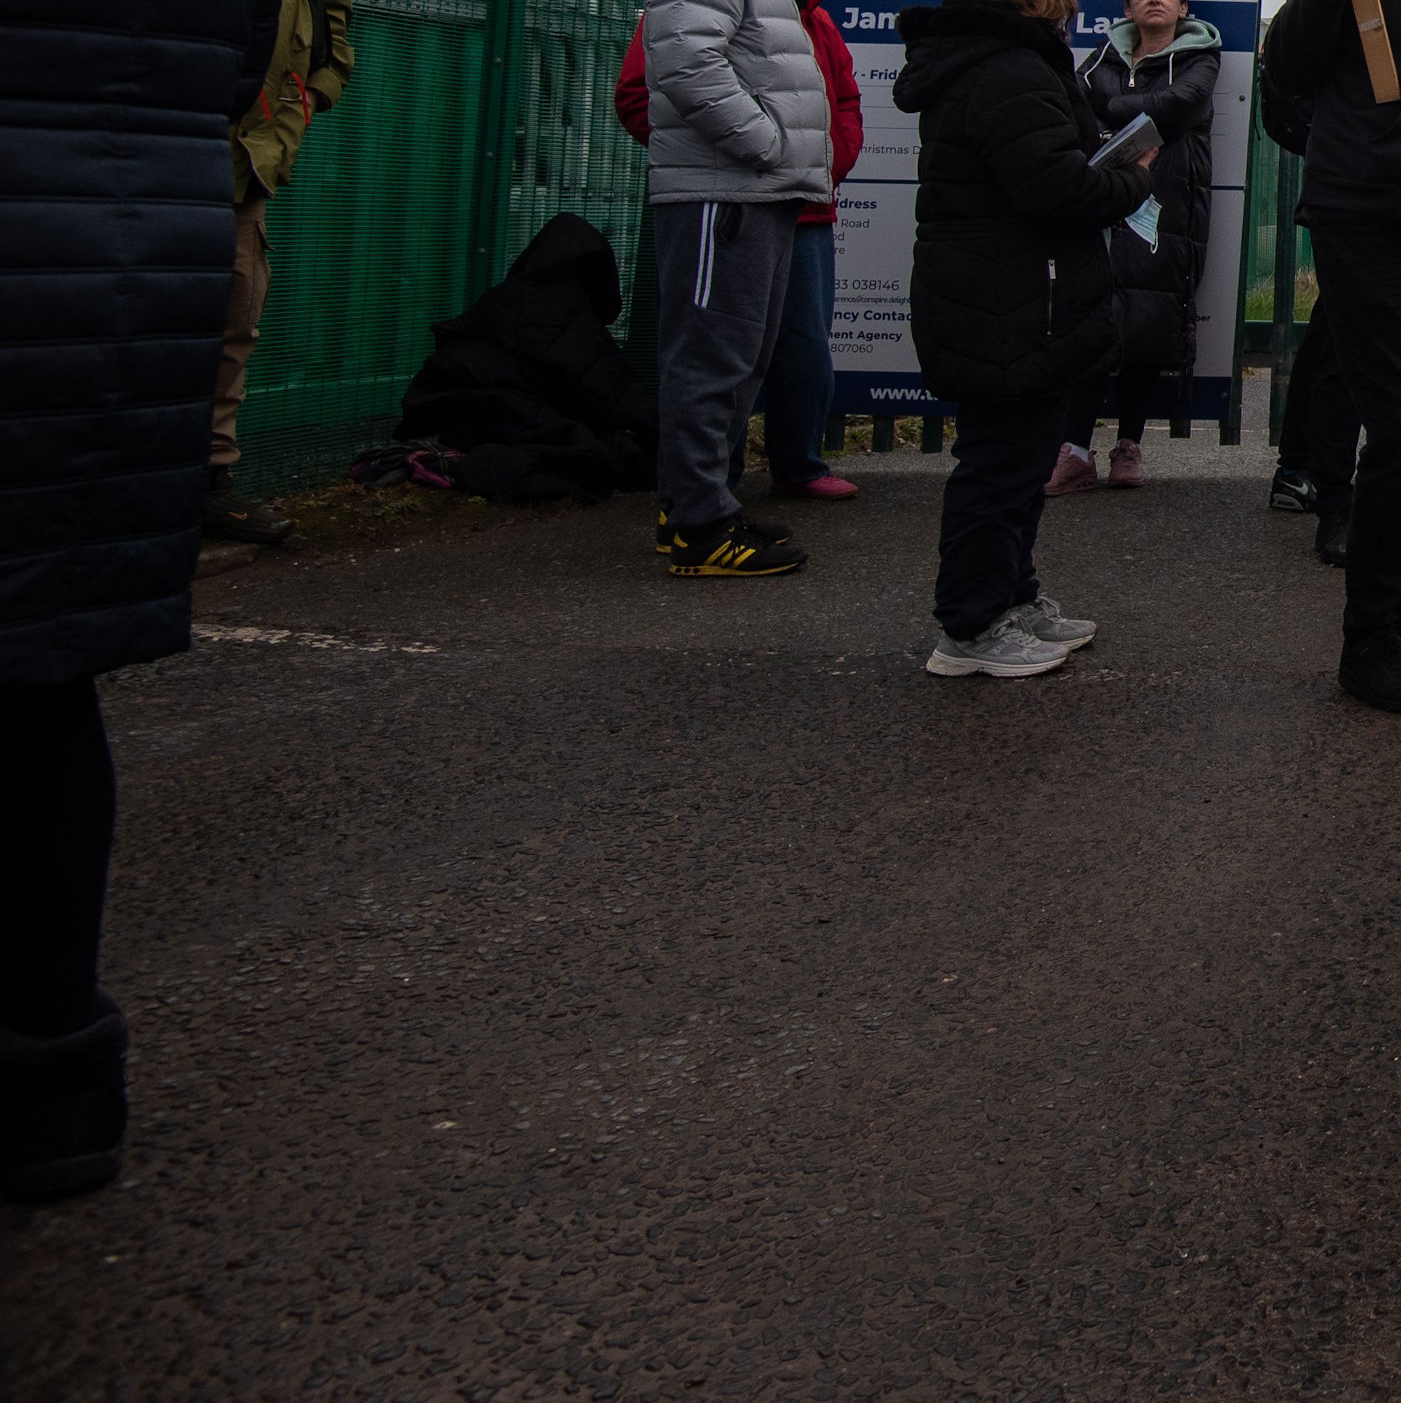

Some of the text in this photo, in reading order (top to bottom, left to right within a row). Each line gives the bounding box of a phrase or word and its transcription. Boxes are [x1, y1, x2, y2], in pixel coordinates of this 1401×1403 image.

[841, 218, 870, 229] Road
[852, 278, 900, 291] 038146
[857, 329, 903, 342] Agency
[830, 342, 873, 354] 807060
